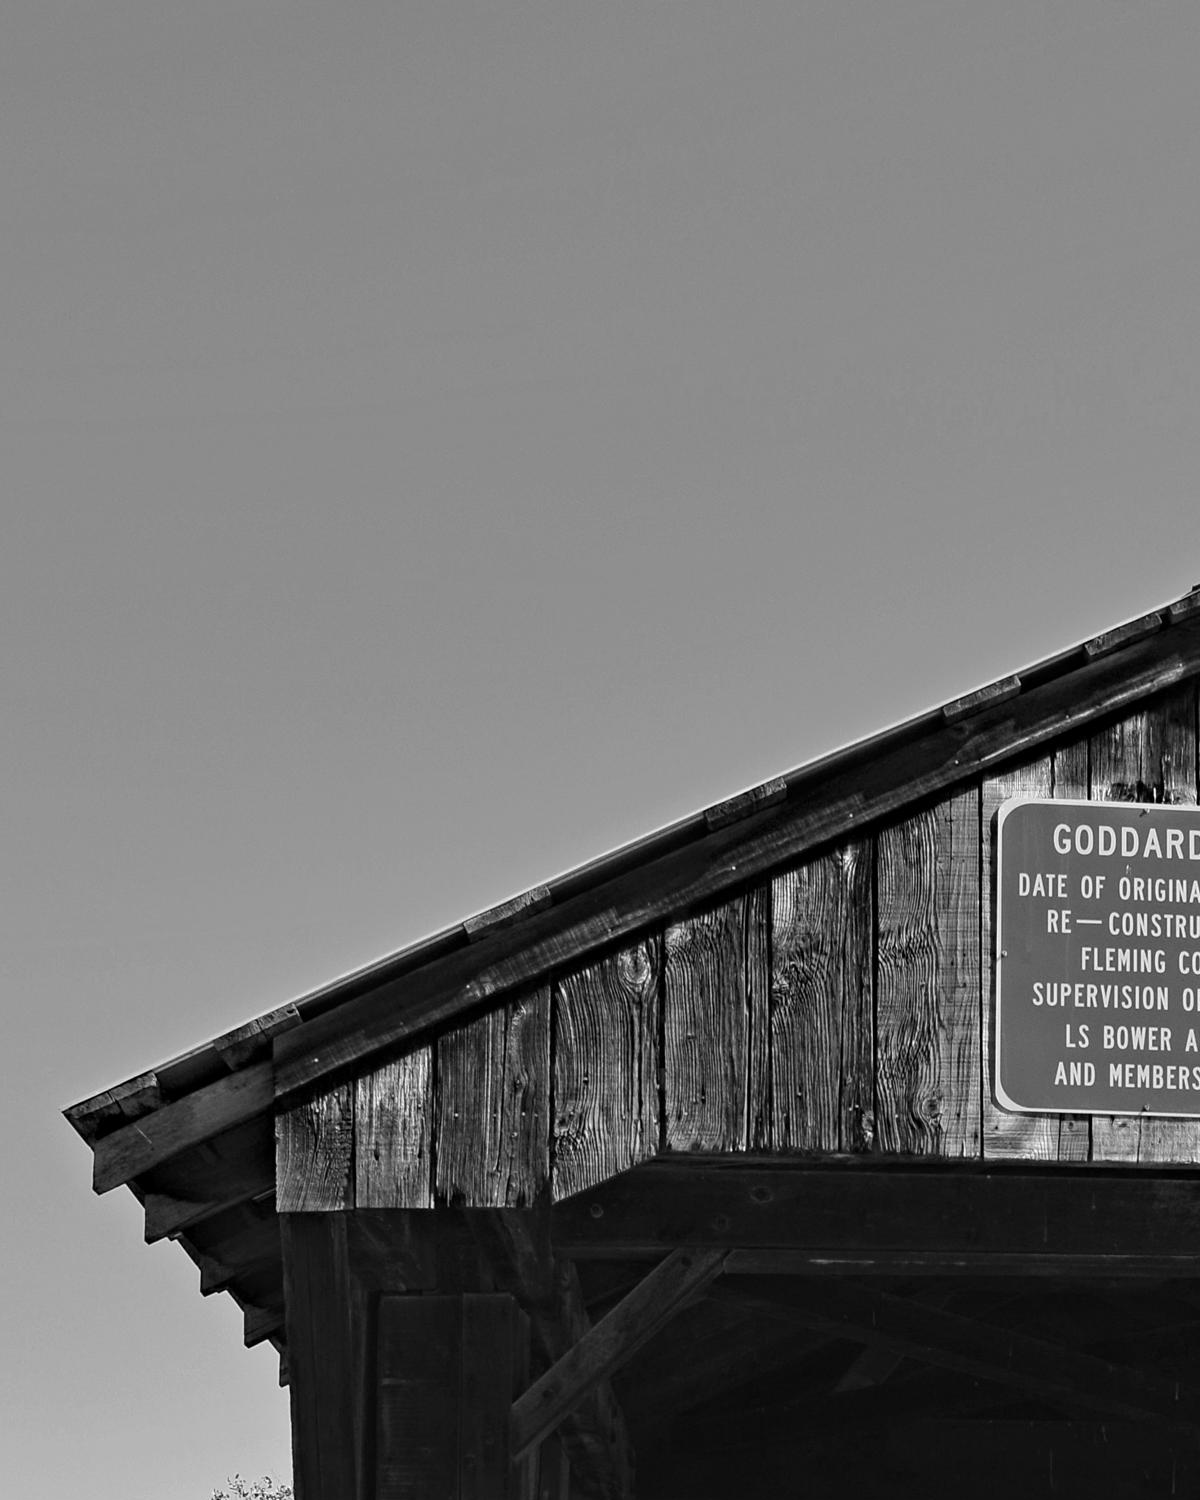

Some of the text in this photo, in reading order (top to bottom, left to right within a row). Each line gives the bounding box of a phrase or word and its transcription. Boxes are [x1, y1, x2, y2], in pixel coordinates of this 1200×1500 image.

[1018, 872, 1068, 899] DATE
[1080, 874, 1106, 900] OF
[1081, 946, 1166, 974] FLEMING
[1032, 981, 1169, 1011] SUPERVISION
[1065, 1023, 1090, 1049] LS
[1103, 1024, 1172, 1052] BOWER
[1054, 1061, 1096, 1087] AND
